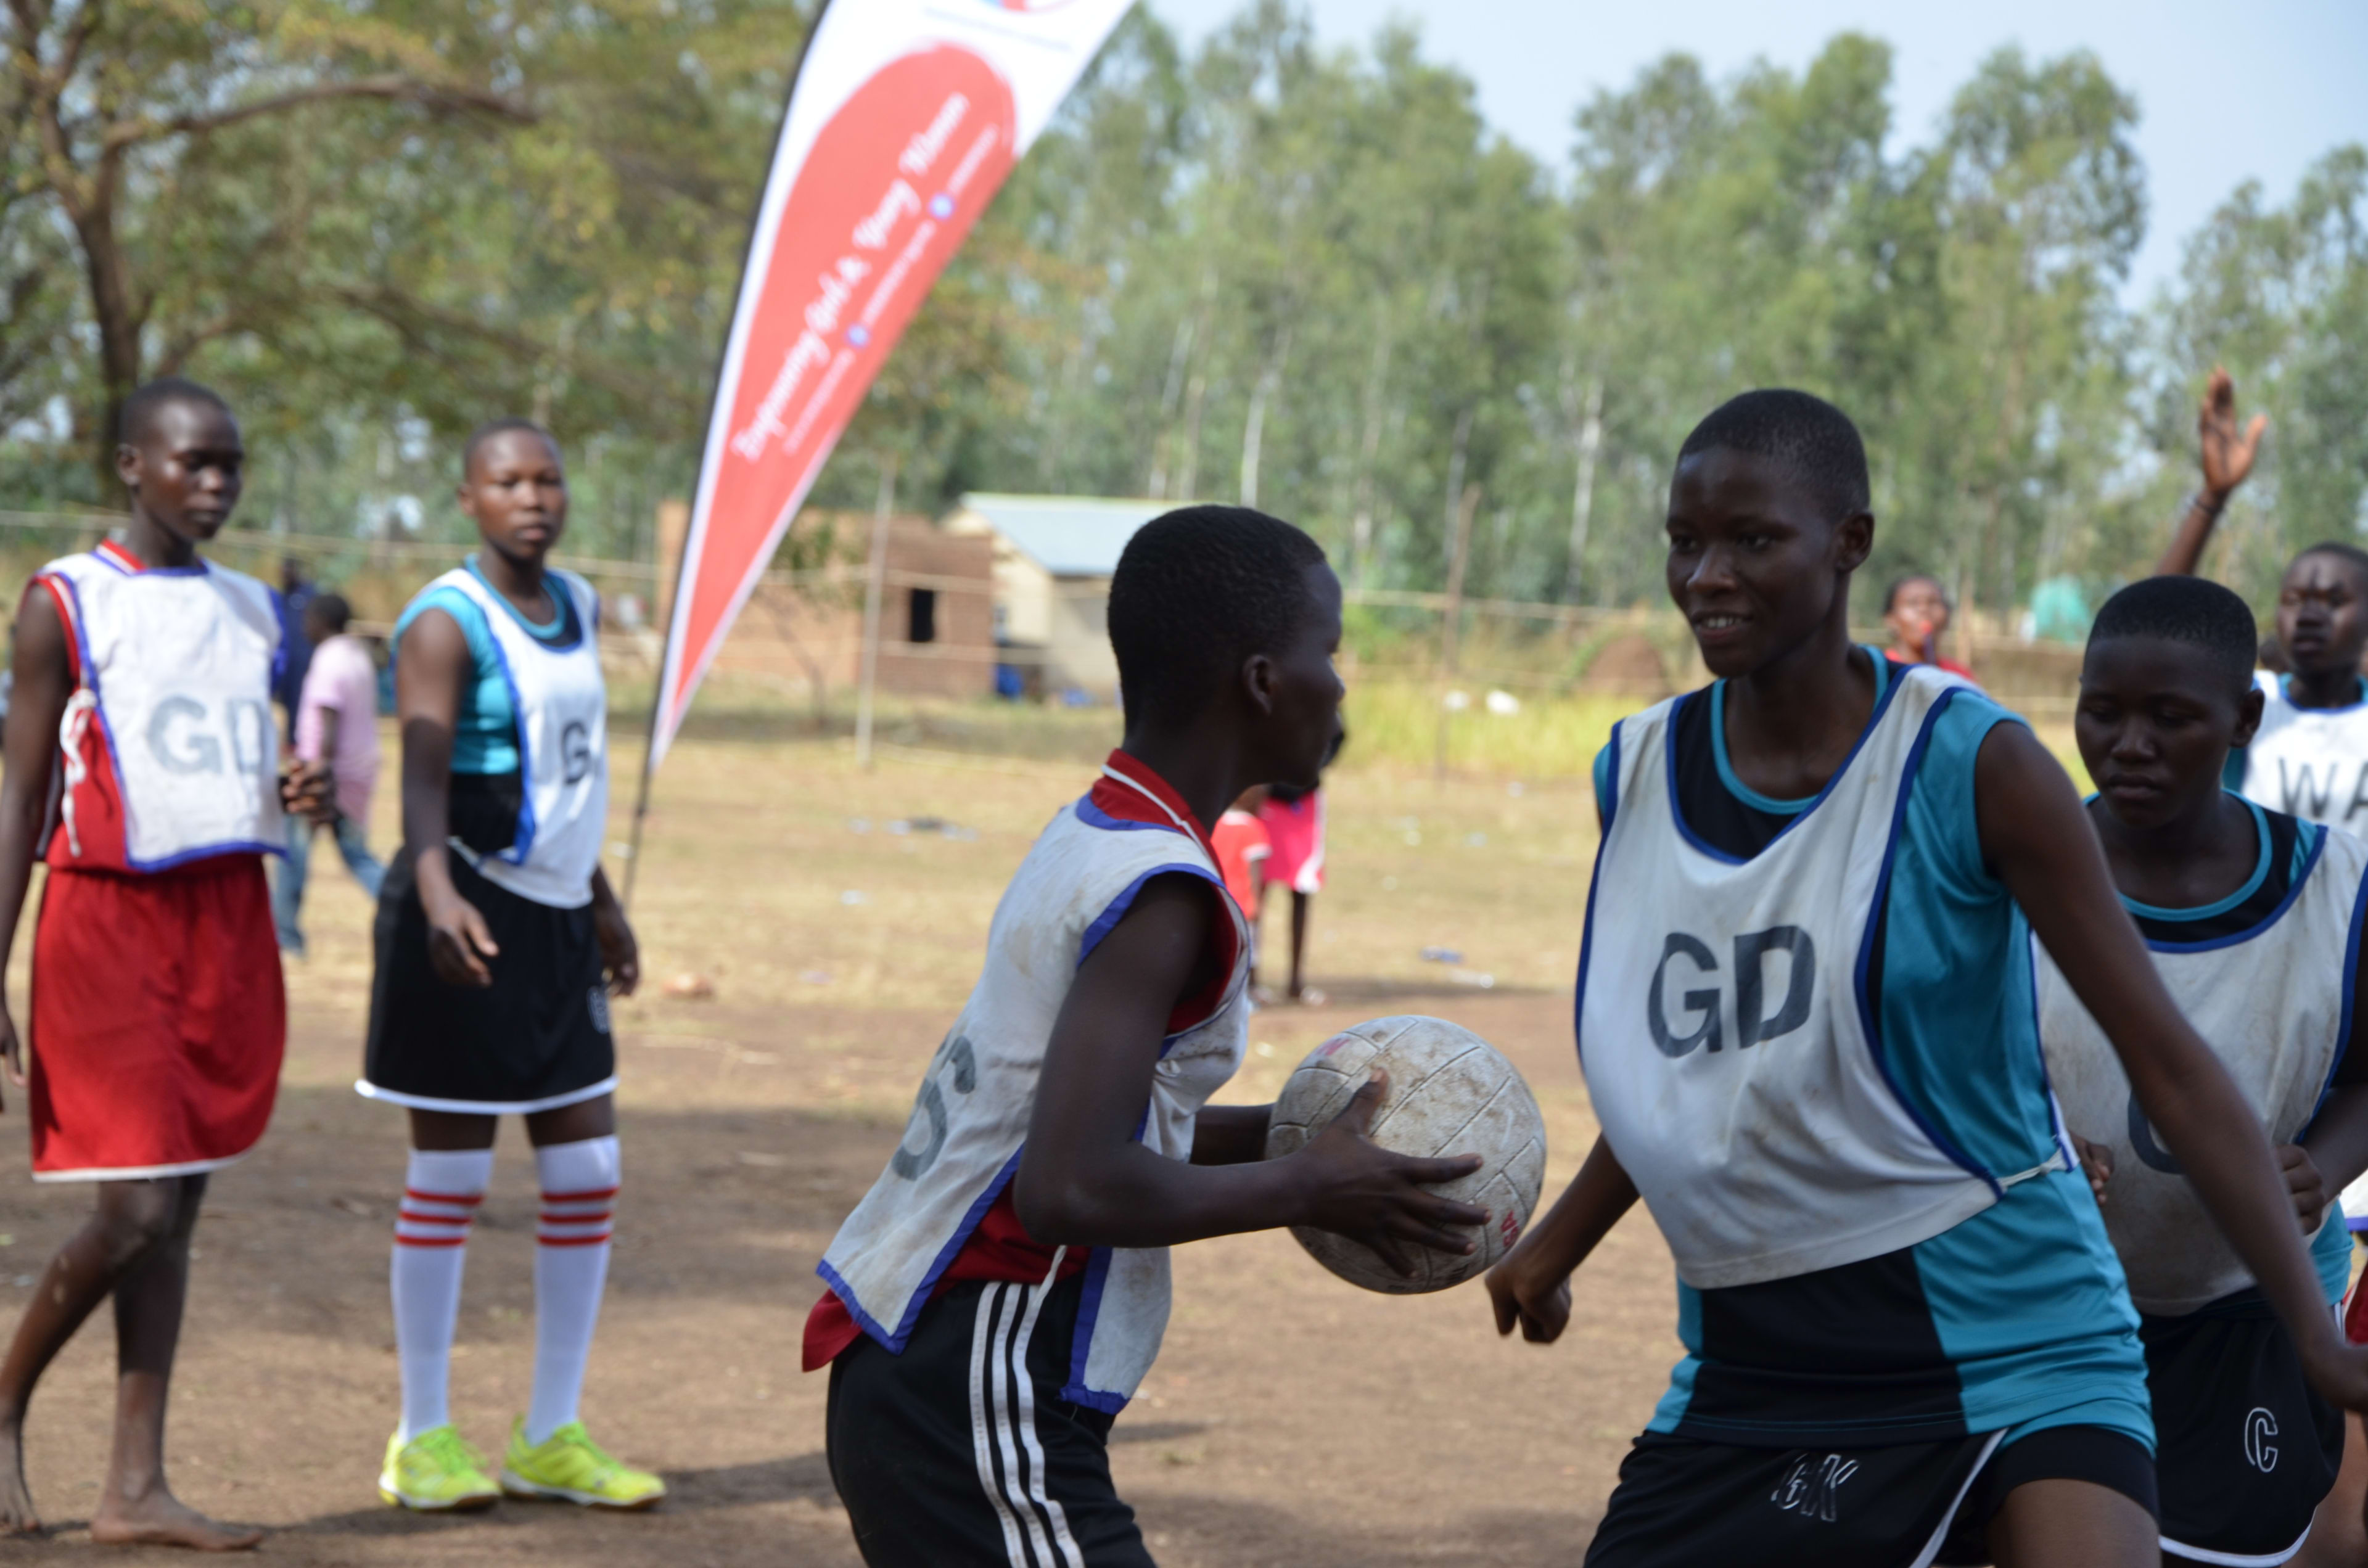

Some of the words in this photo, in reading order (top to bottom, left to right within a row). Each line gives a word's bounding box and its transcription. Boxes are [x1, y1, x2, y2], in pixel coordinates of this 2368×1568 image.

[145, 695, 276, 776] GD
[1648, 924, 1815, 1059] GD
[2245, 1406, 2279, 1473] C
